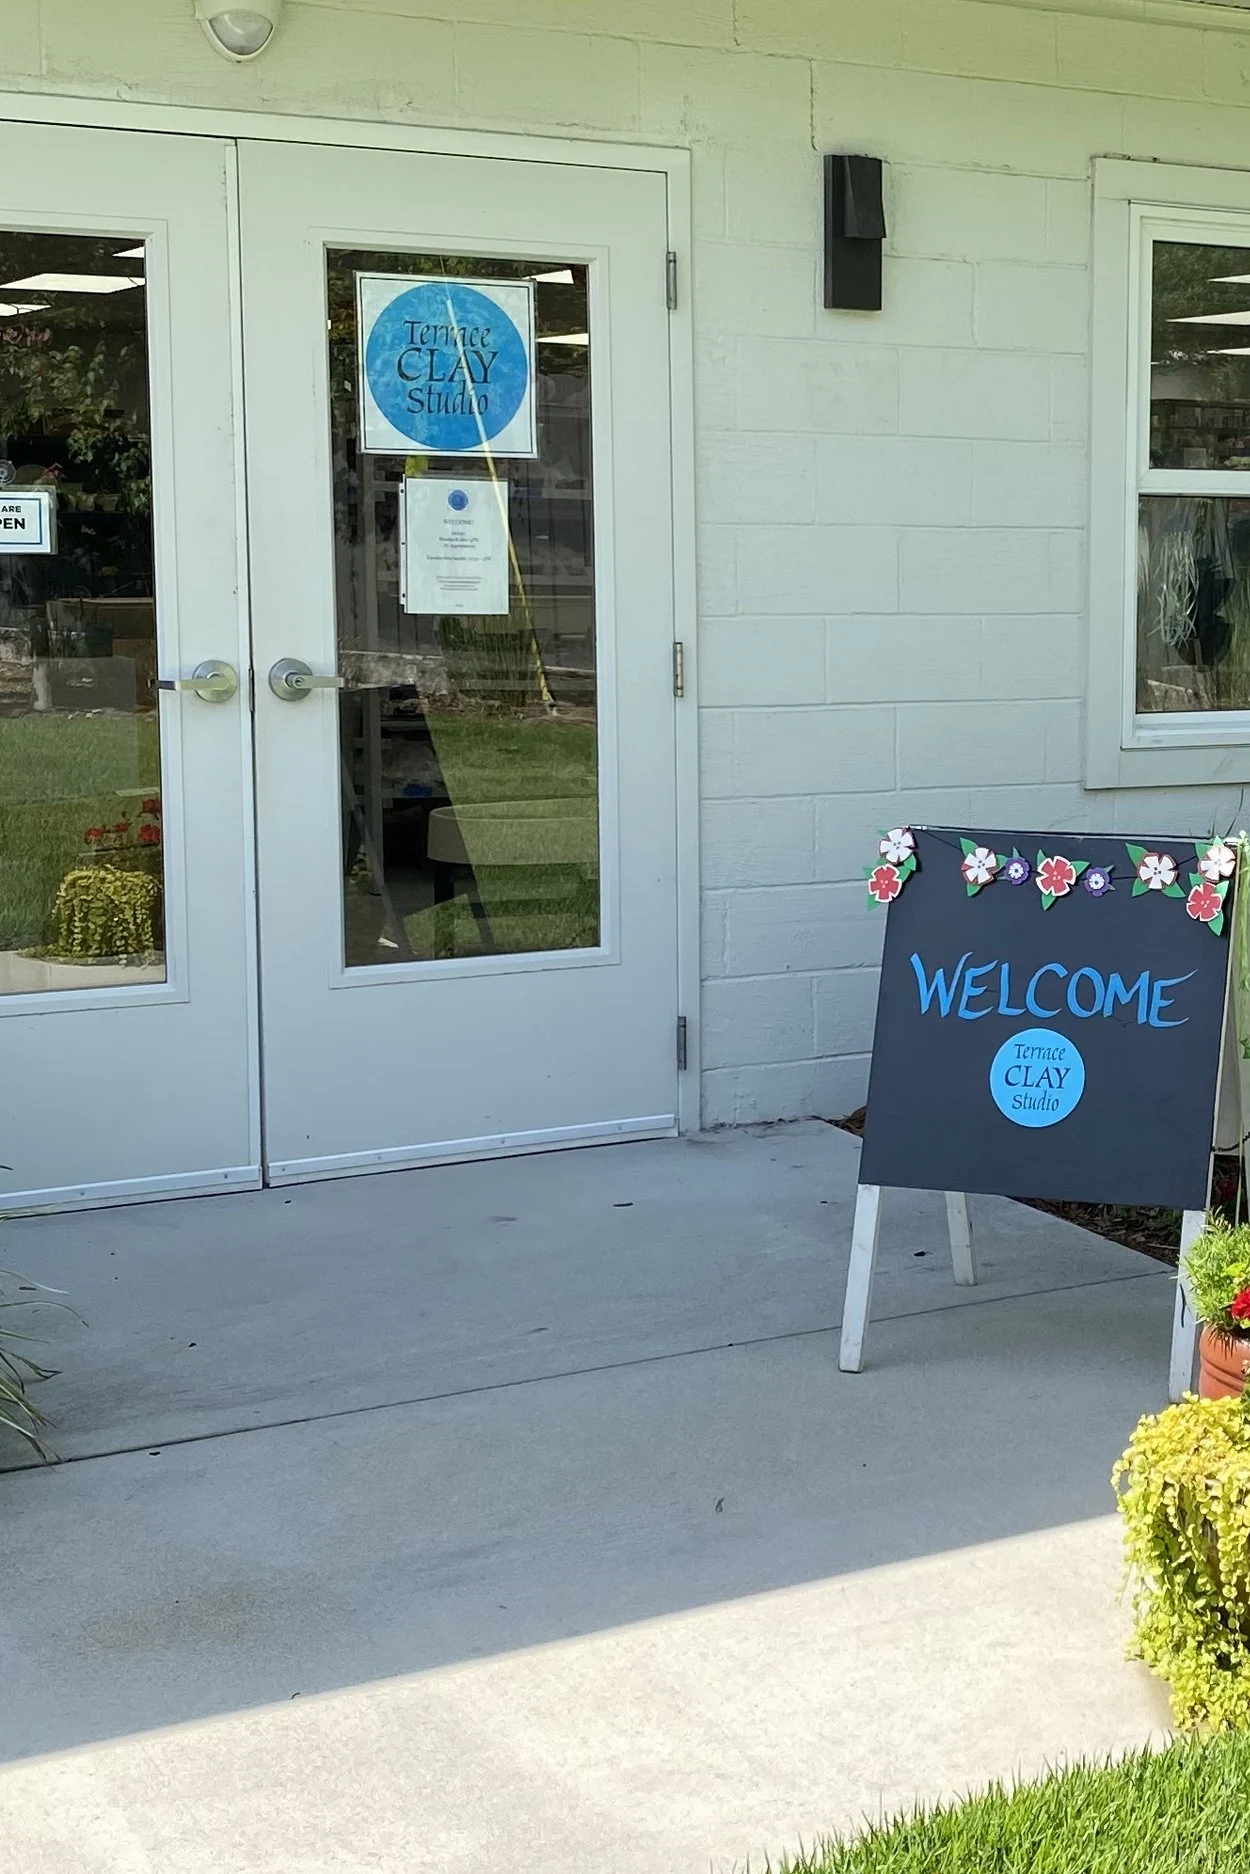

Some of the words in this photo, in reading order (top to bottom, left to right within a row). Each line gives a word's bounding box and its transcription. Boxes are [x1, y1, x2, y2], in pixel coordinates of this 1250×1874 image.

[404, 320, 491, 347] Terrace
[397, 347, 498, 384] CLAY
[407, 380, 488, 416] Studio
[1, 505, 22, 513] ARE
[910, 952, 1198, 1028] WELCOME
[1014, 1044, 1066, 1061] Terrace
[1005, 1065, 1071, 1089] CLAY
[1012, 1091, 1059, 1112] Studio
